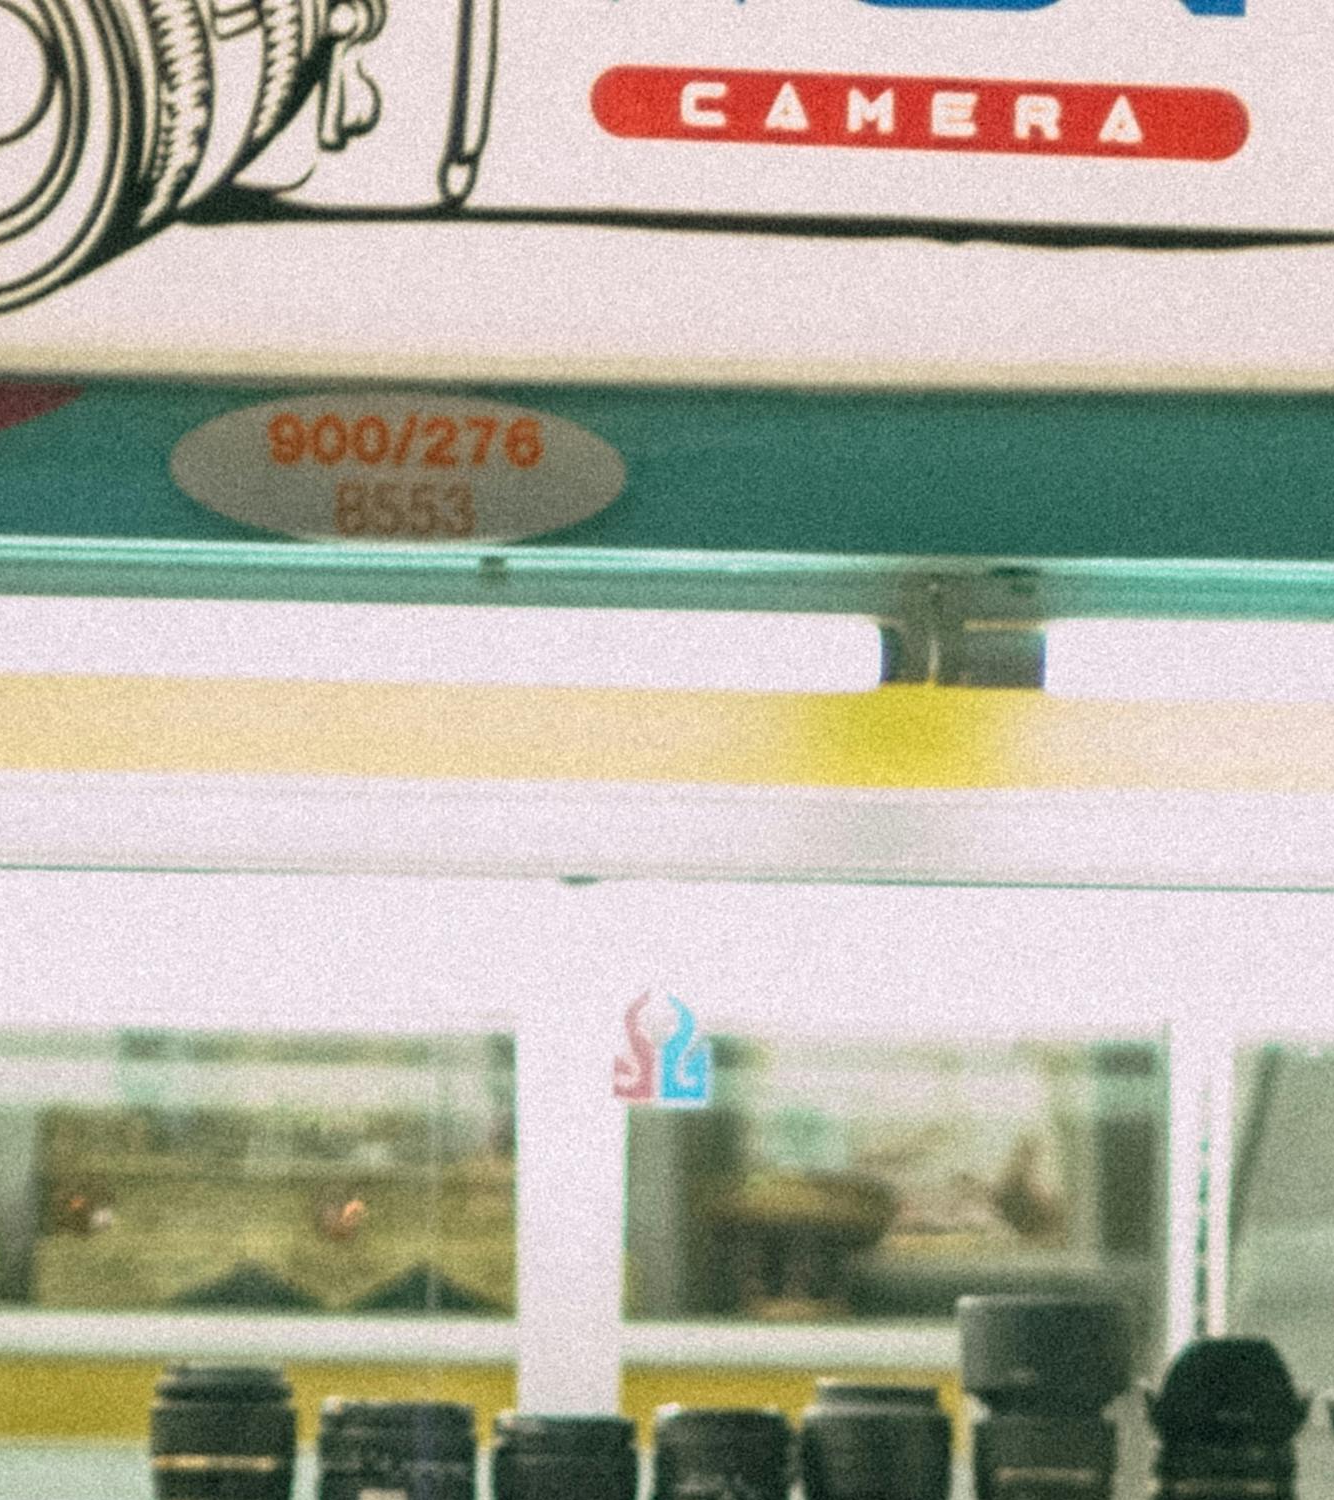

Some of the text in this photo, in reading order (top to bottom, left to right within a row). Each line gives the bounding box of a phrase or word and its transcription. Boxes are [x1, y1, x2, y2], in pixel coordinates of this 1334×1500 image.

[679, 81, 1143, 144] CAMERA
[267, 411, 546, 469] 900/276
[335, 480, 476, 538] 8553
